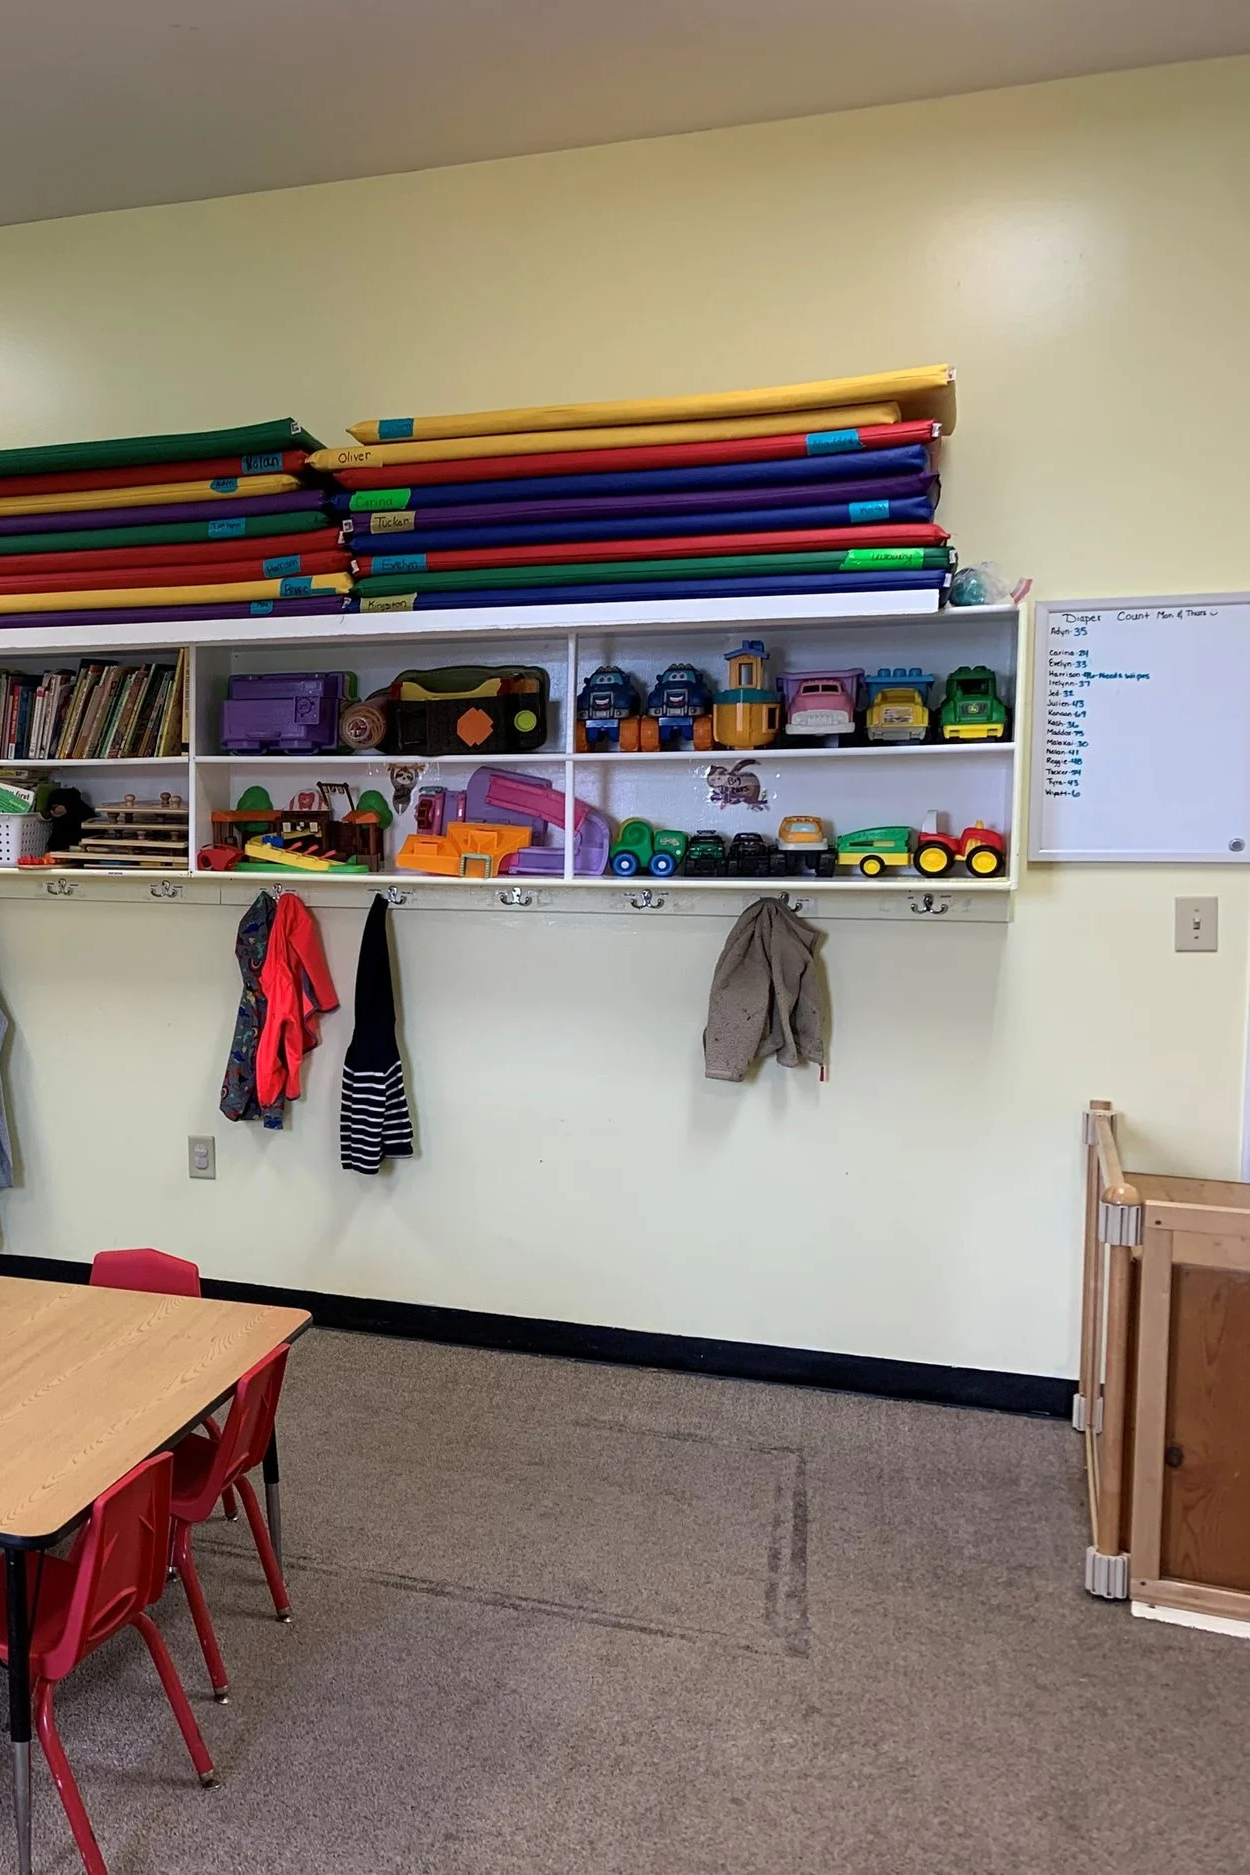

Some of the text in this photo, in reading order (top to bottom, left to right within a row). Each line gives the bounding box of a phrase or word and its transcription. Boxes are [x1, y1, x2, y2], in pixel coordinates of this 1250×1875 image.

[338, 451, 372, 464] Oliver
[355, 495, 394, 508] Carina
[374, 516, 409, 529] Tucker
[381, 558, 418, 572] Evelyn
[368, 600, 407, 612] Kingston
[1062, 613, 1101, 625] Diaper
[1117, 611, 1151, 622] Count
[1156, 611, 1174, 620] Mon
